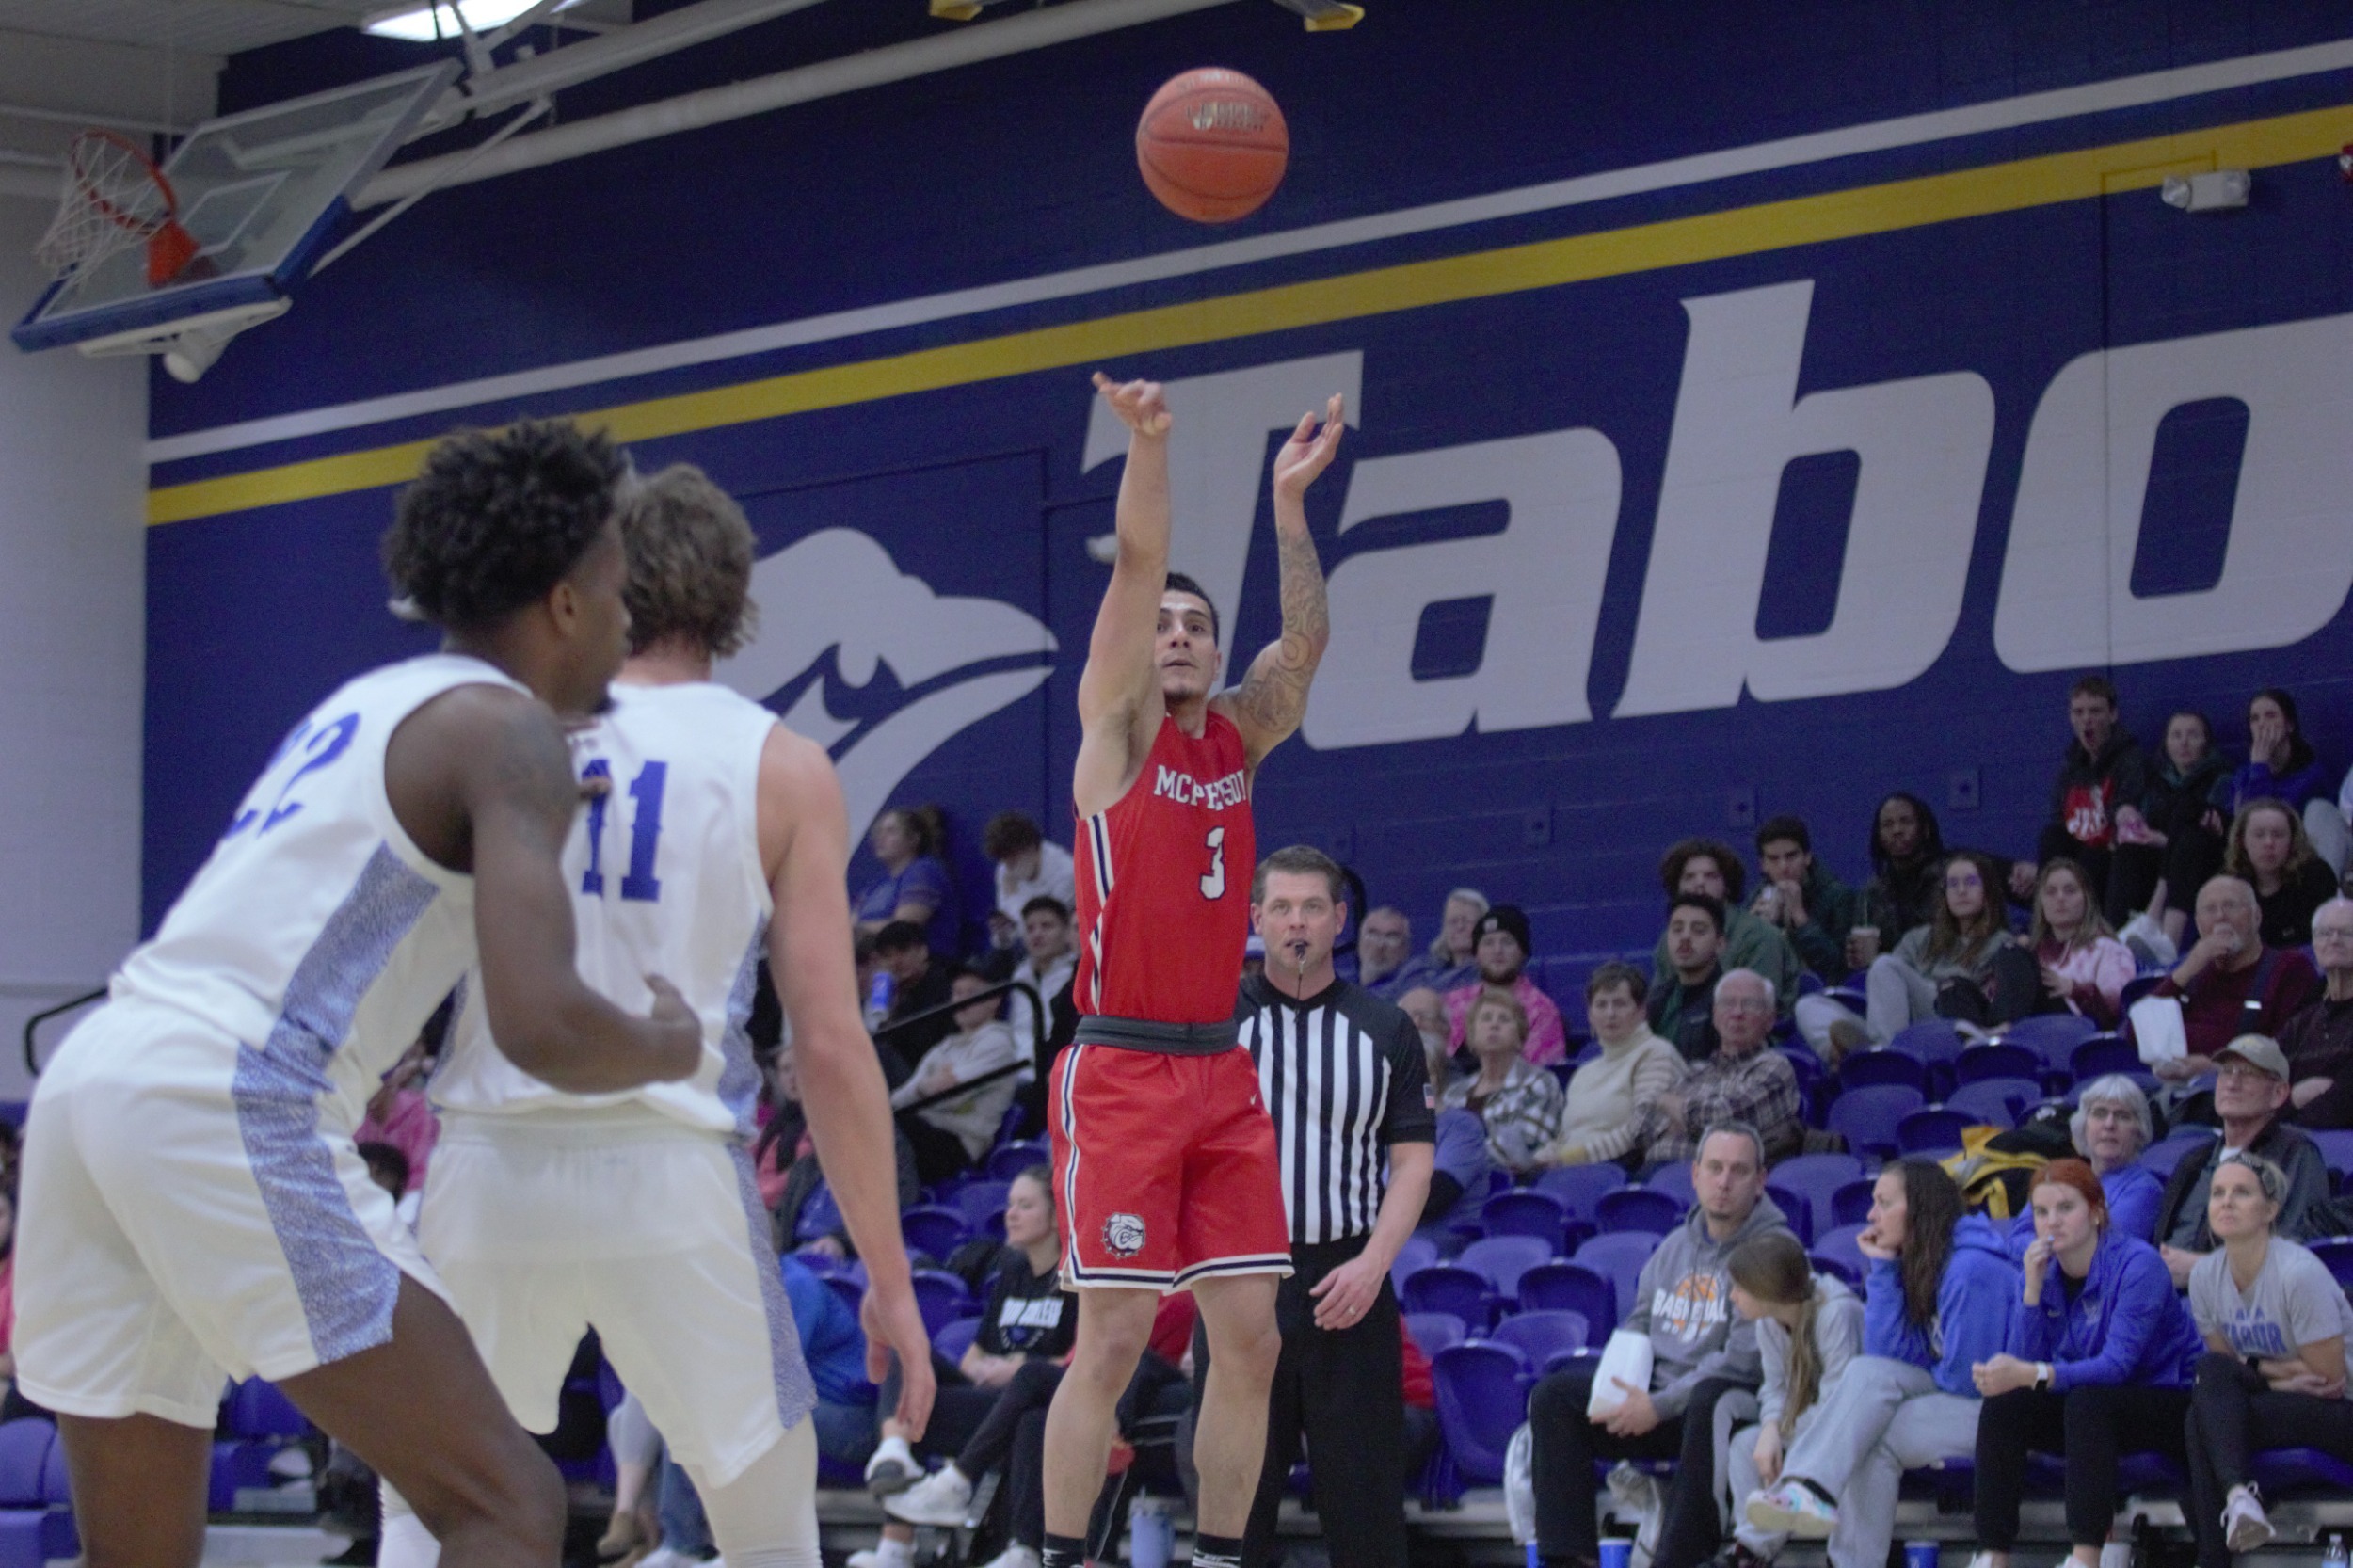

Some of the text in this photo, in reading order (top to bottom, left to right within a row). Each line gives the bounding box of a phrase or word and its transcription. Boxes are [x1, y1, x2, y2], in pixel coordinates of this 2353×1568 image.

[1153, 764, 1247, 811] MCPESO
[581, 759, 668, 902] 11
[1199, 826, 1225, 901] 3
